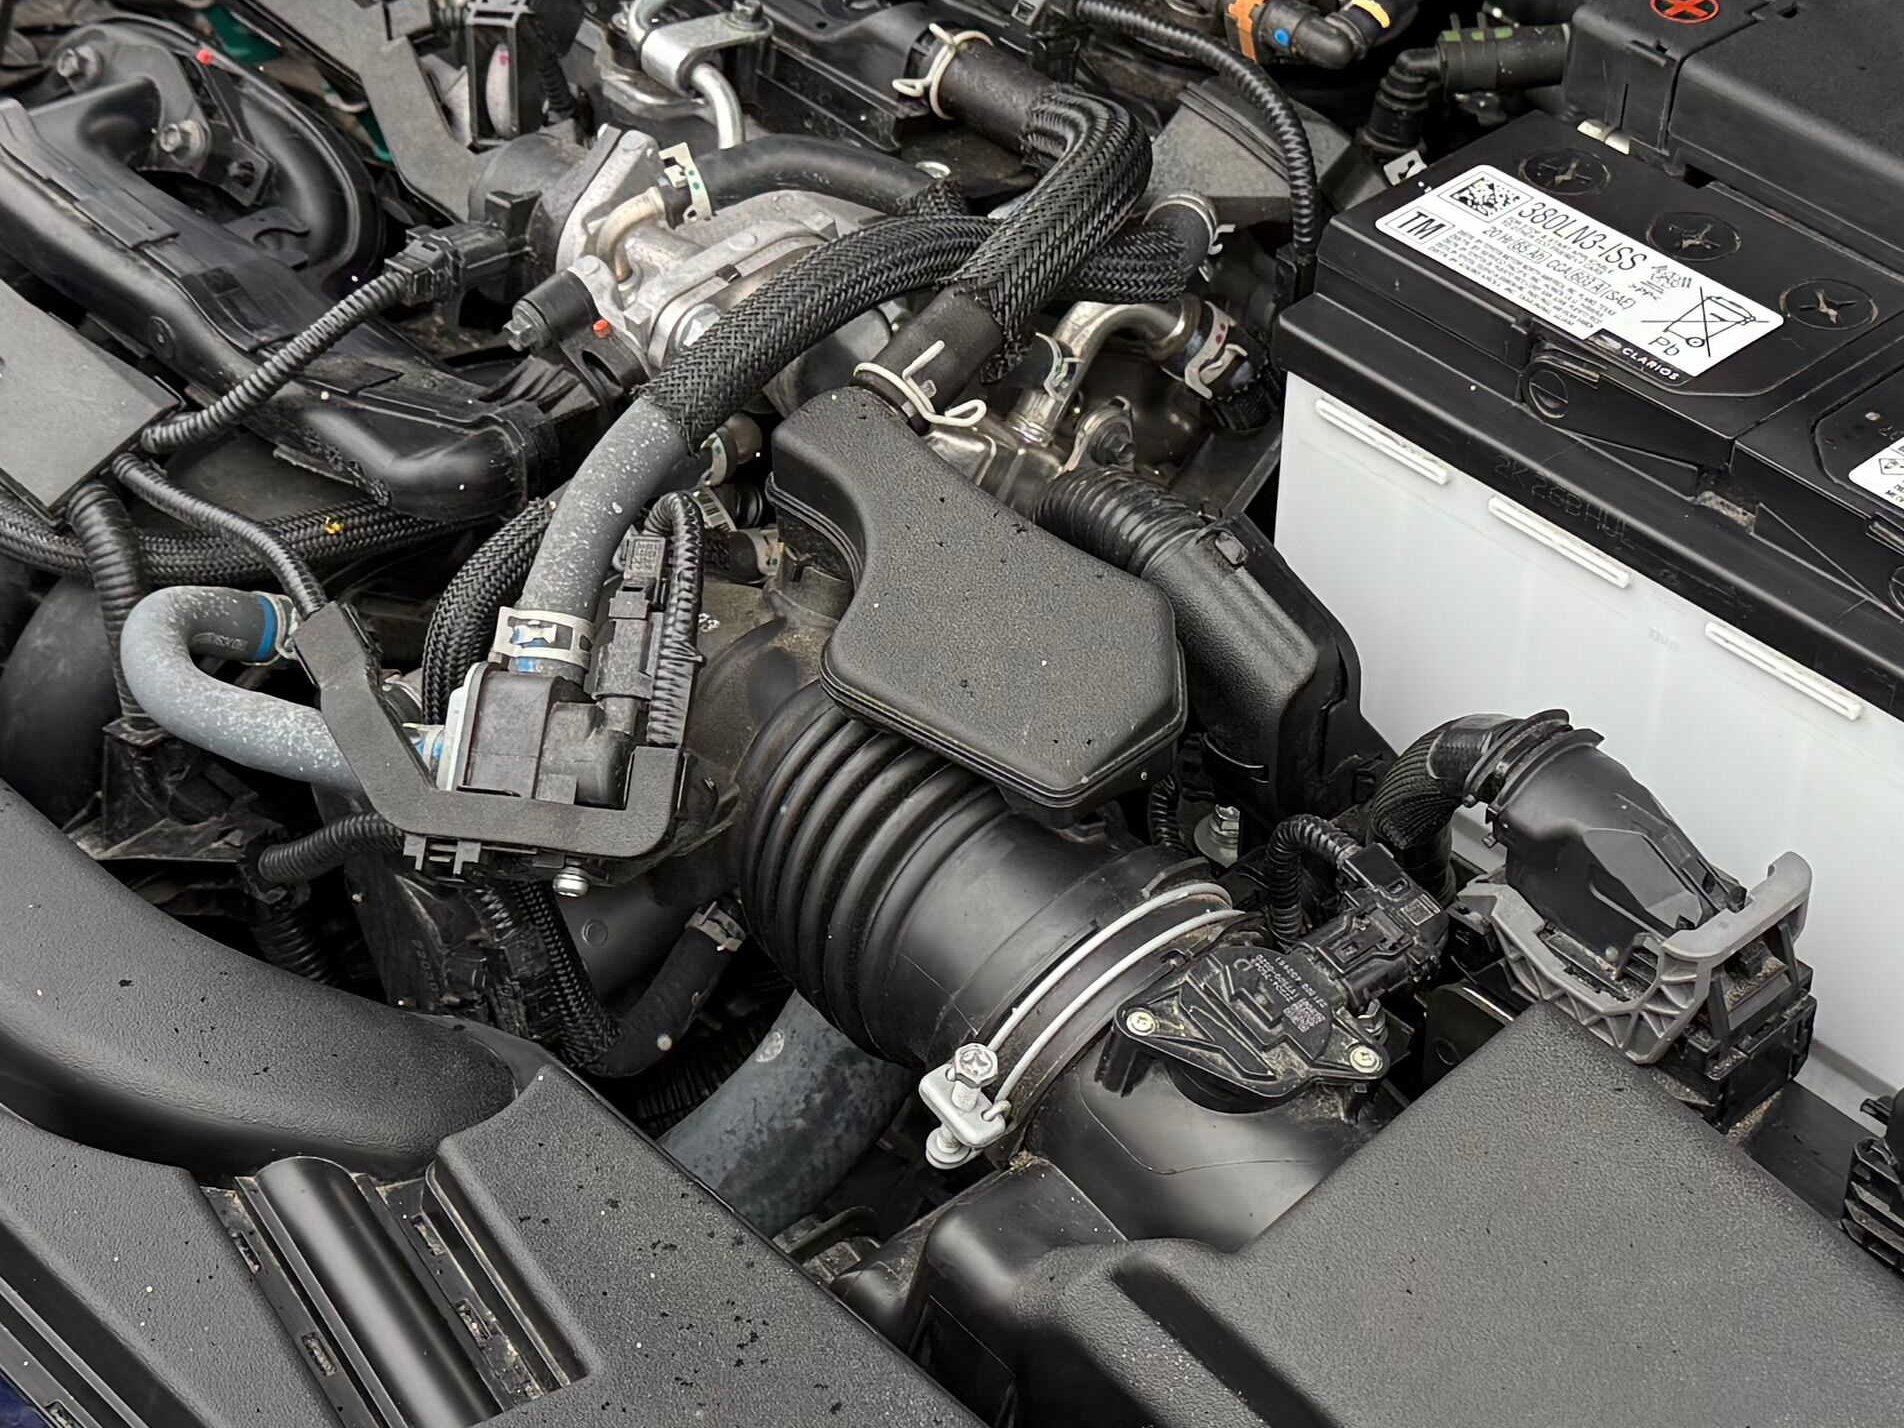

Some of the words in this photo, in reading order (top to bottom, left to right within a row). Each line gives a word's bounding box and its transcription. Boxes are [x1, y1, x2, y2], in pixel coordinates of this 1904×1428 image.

[1392, 210, 1447, 241] TM
[1481, 225, 1504, 238] 20
[1519, 201, 1648, 273] 380LN3-ISS
[1644, 334, 1686, 358] Pb
[1621, 344, 1681, 383] CLARIOS
